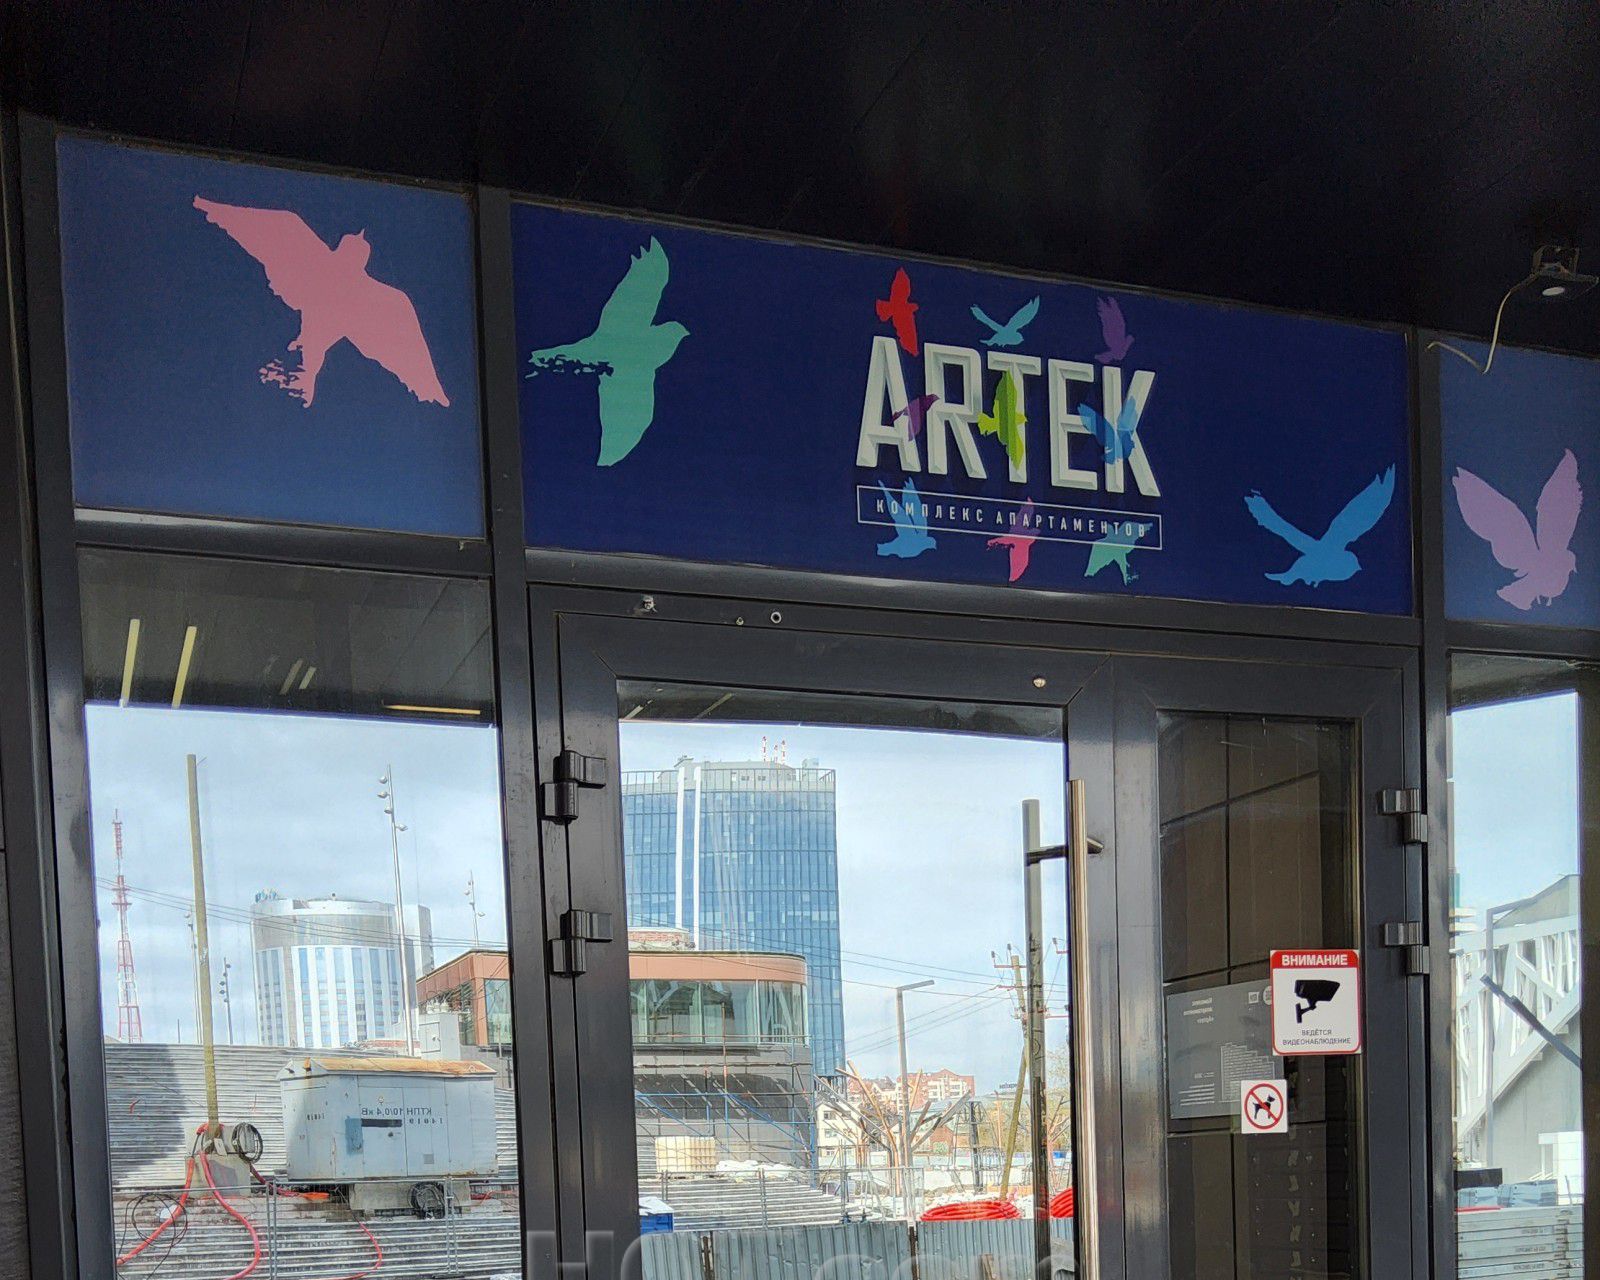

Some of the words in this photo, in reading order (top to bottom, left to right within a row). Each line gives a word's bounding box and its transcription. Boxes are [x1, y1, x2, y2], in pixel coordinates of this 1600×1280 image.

[856, 336, 1161, 497] ARTEK
[876, 499, 984, 523] КОМПЛЕКС
[995, 511, 1146, 538] АПАРТАМЕНТОВ
[1281, 954, 1349, 967] ВНИМАНИЕ
[1301, 1027, 1332, 1037] ВЕДЁТСЯ
[1282, 1037, 1351, 1046] ВИДЕОНАБЛЮДЕНИЕ
